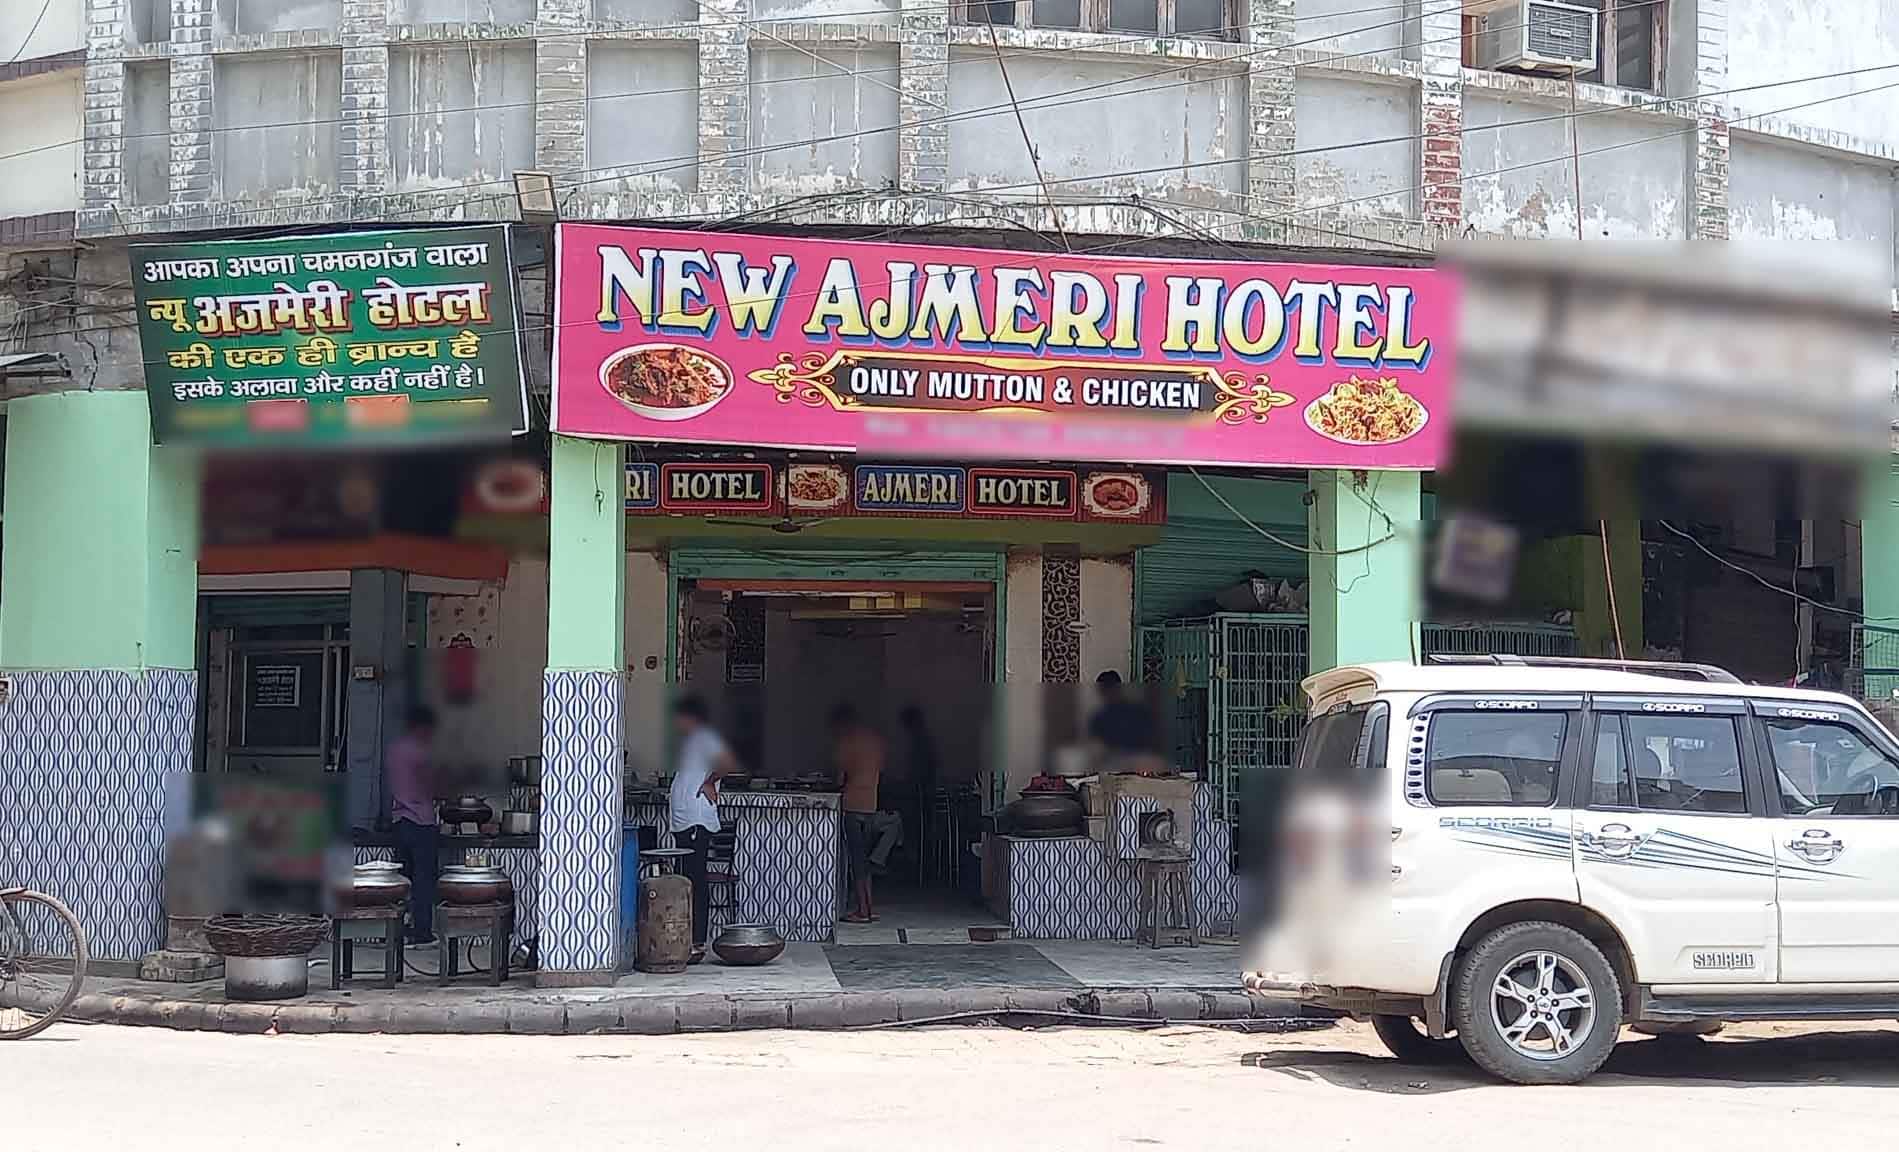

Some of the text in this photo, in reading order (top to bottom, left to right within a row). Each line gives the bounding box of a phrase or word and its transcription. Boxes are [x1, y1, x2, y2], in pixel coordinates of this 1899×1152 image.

[144, 242, 489, 282] आपका अपना चमनगंज वाला
[146, 277, 492, 337] न्यू अजमेरी होटल
[597, 245, 1431, 373] NEW AJMERI HOTEL
[168, 346, 215, 369] की
[223, 350, 285, 367] एक
[295, 338, 338, 365] ही
[449, 330, 481, 358] है
[173, 376, 225, 401] इसके
[230, 378, 297, 396] अलावा
[304, 372, 344, 394] और
[349, 368, 400, 391] कहीं
[403, 364, 450, 388] नहीं
[850, 366, 1201, 408] ONLY MUTTON & CHICKEN
[671, 472, 761, 500] HOTEL
[862, 472, 958, 504] AJMERI
[977, 478, 1067, 506] HOTEL
